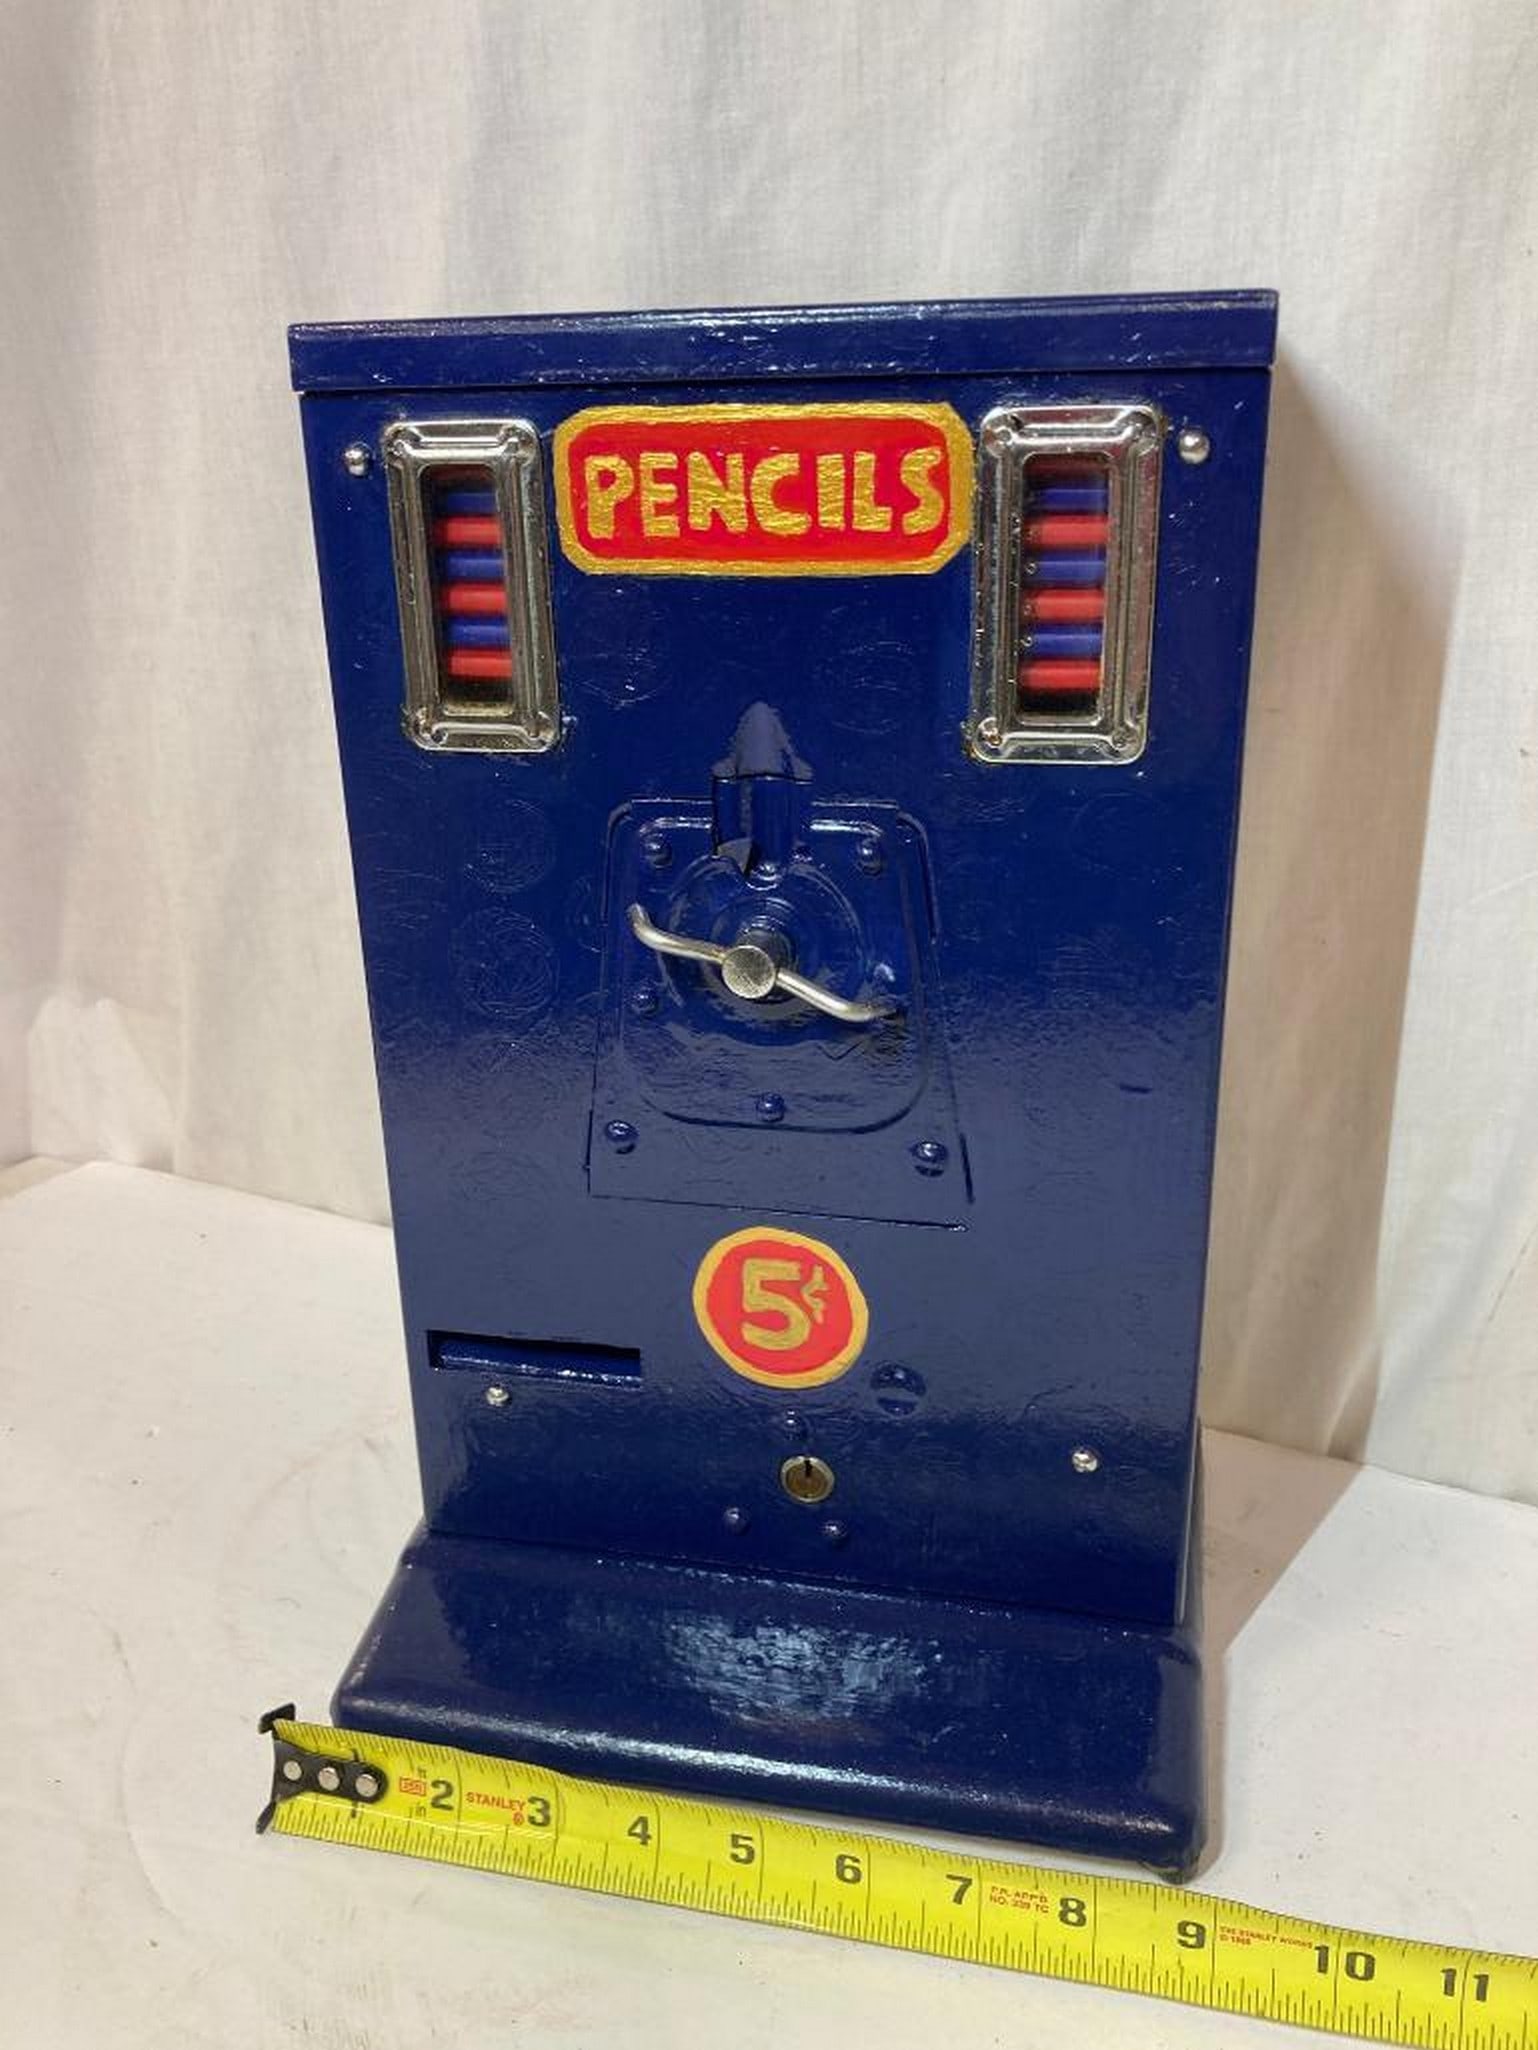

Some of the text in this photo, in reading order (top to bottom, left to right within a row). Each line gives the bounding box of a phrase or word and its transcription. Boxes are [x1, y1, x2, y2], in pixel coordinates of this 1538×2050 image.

[584, 446, 945, 540] PENCILS
[431, 1779, 454, 1811] 2
[466, 1792, 526, 1811] STANLEY
[527, 1796, 551, 1827] 3
[627, 1816, 652, 1846] 4
[730, 1833, 756, 1865] 5
[835, 1853, 862, 1884] 6
[945, 1873, 973, 1906] 7
[1058, 1897, 1087, 1927] 8
[1177, 1920, 1206, 1950] 9
[1314, 1944, 1376, 1981] 10
[1440, 1967, 1490, 2002] 11
